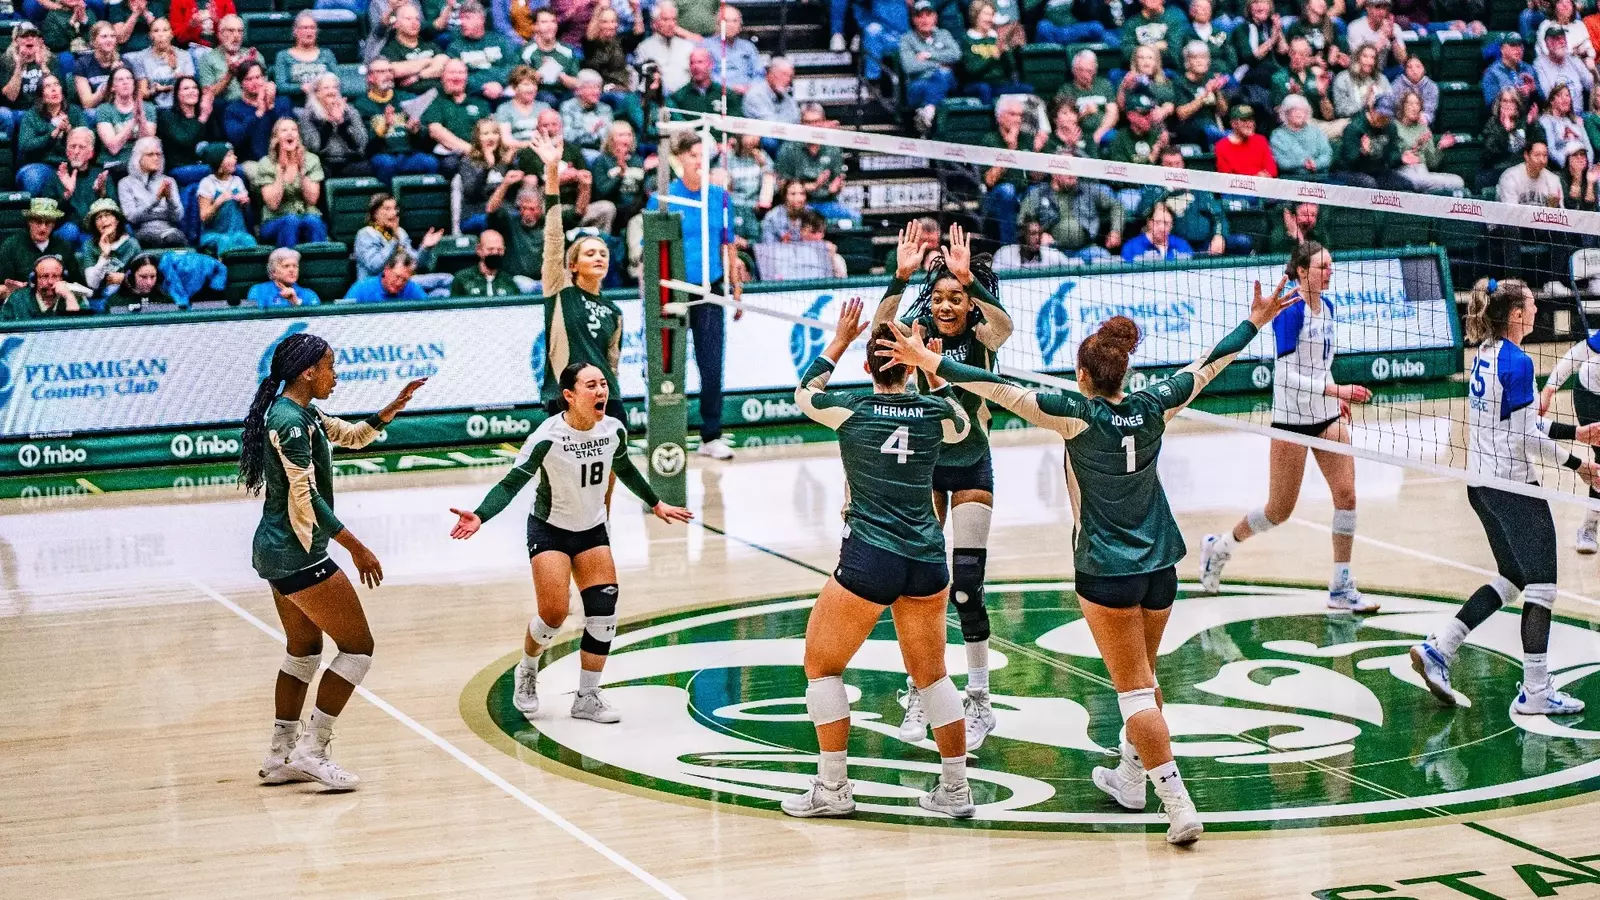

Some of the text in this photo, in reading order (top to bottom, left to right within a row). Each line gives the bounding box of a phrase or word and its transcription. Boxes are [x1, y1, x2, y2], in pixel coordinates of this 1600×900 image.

[1532, 208, 1569, 226] uchealth
[334, 342, 446, 364] ARMIGAN
[25, 356, 168, 383] PTARMIGAN
[395, 361, 440, 378] Club
[31, 378, 159, 400] Country Club
[873, 404, 924, 418] HERMAN
[489, 415, 531, 434] fnbo
[195, 435, 239, 455] fnbo
[563, 437, 610, 452] COLORADO
[575, 448, 603, 458] STATE
[881, 426, 915, 464] 4
[1121, 435, 1136, 472] 1
[42, 445, 87, 464] fnbo
[581, 461, 604, 488] 18
